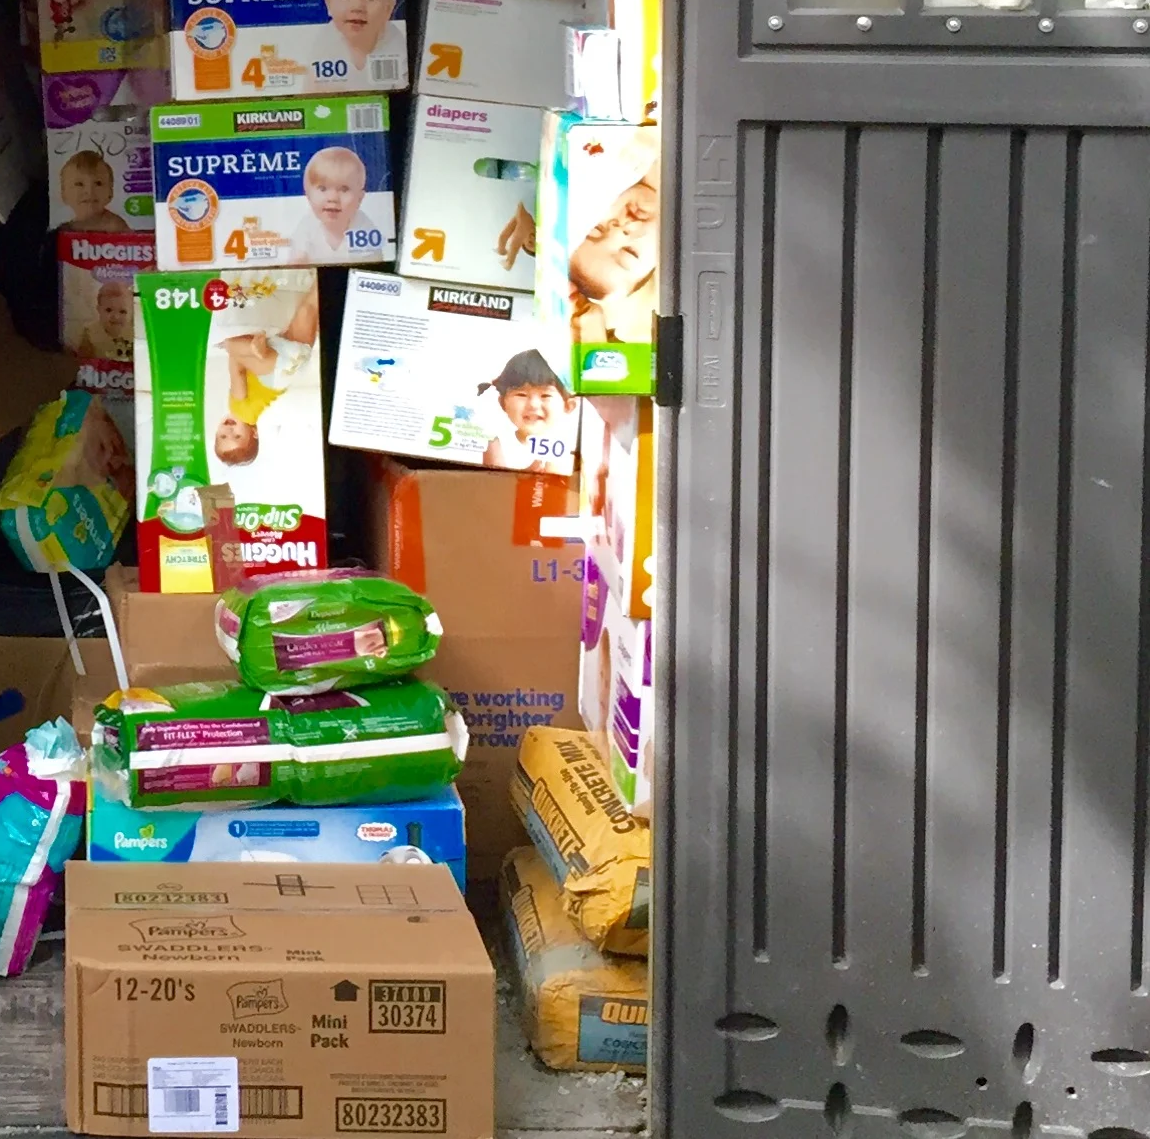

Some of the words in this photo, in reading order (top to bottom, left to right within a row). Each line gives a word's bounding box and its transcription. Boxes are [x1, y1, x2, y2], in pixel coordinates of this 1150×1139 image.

[241, 57, 266, 88] 4
[312, 59, 348, 78] 180
[236, 111, 303, 124] KIRKLAND
[427, 105, 488, 122] diapers
[168, 149, 301, 177] SUPRÊME
[223, 230, 249, 260] 4
[345, 229, 382, 248] 180
[71, 239, 154, 262] HUGGIES
[155, 288, 200, 310] 148
[433, 289, 511, 310] KIRKLAND
[76, 364, 134, 389] HUGG
[429, 415, 453, 447] 5
[528, 437, 565, 458] 150
[221, 541, 318, 567] HUGGIES
[472, 688, 565, 711] working
[203, 729, 244, 739] Protection
[553, 740, 588, 765] MIX
[560, 768, 597, 816] Ready-To-Use
[573, 763, 636, 834] CONCRETE
[114, 830, 168, 850] Pampers
[148, 925, 228, 938] Pampers
[142, 953, 240, 961] Newborn
[114, 977, 196, 1002] 12-20's
[235, 993, 284, 1012] Pampers
[311, 1013, 348, 1030] Mini
[377, 1004, 438, 1028] 30374
[232, 1037, 284, 1049] Newborn
[311, 1032, 349, 1049] Pack
[342, 1102, 440, 1128] 80232383
